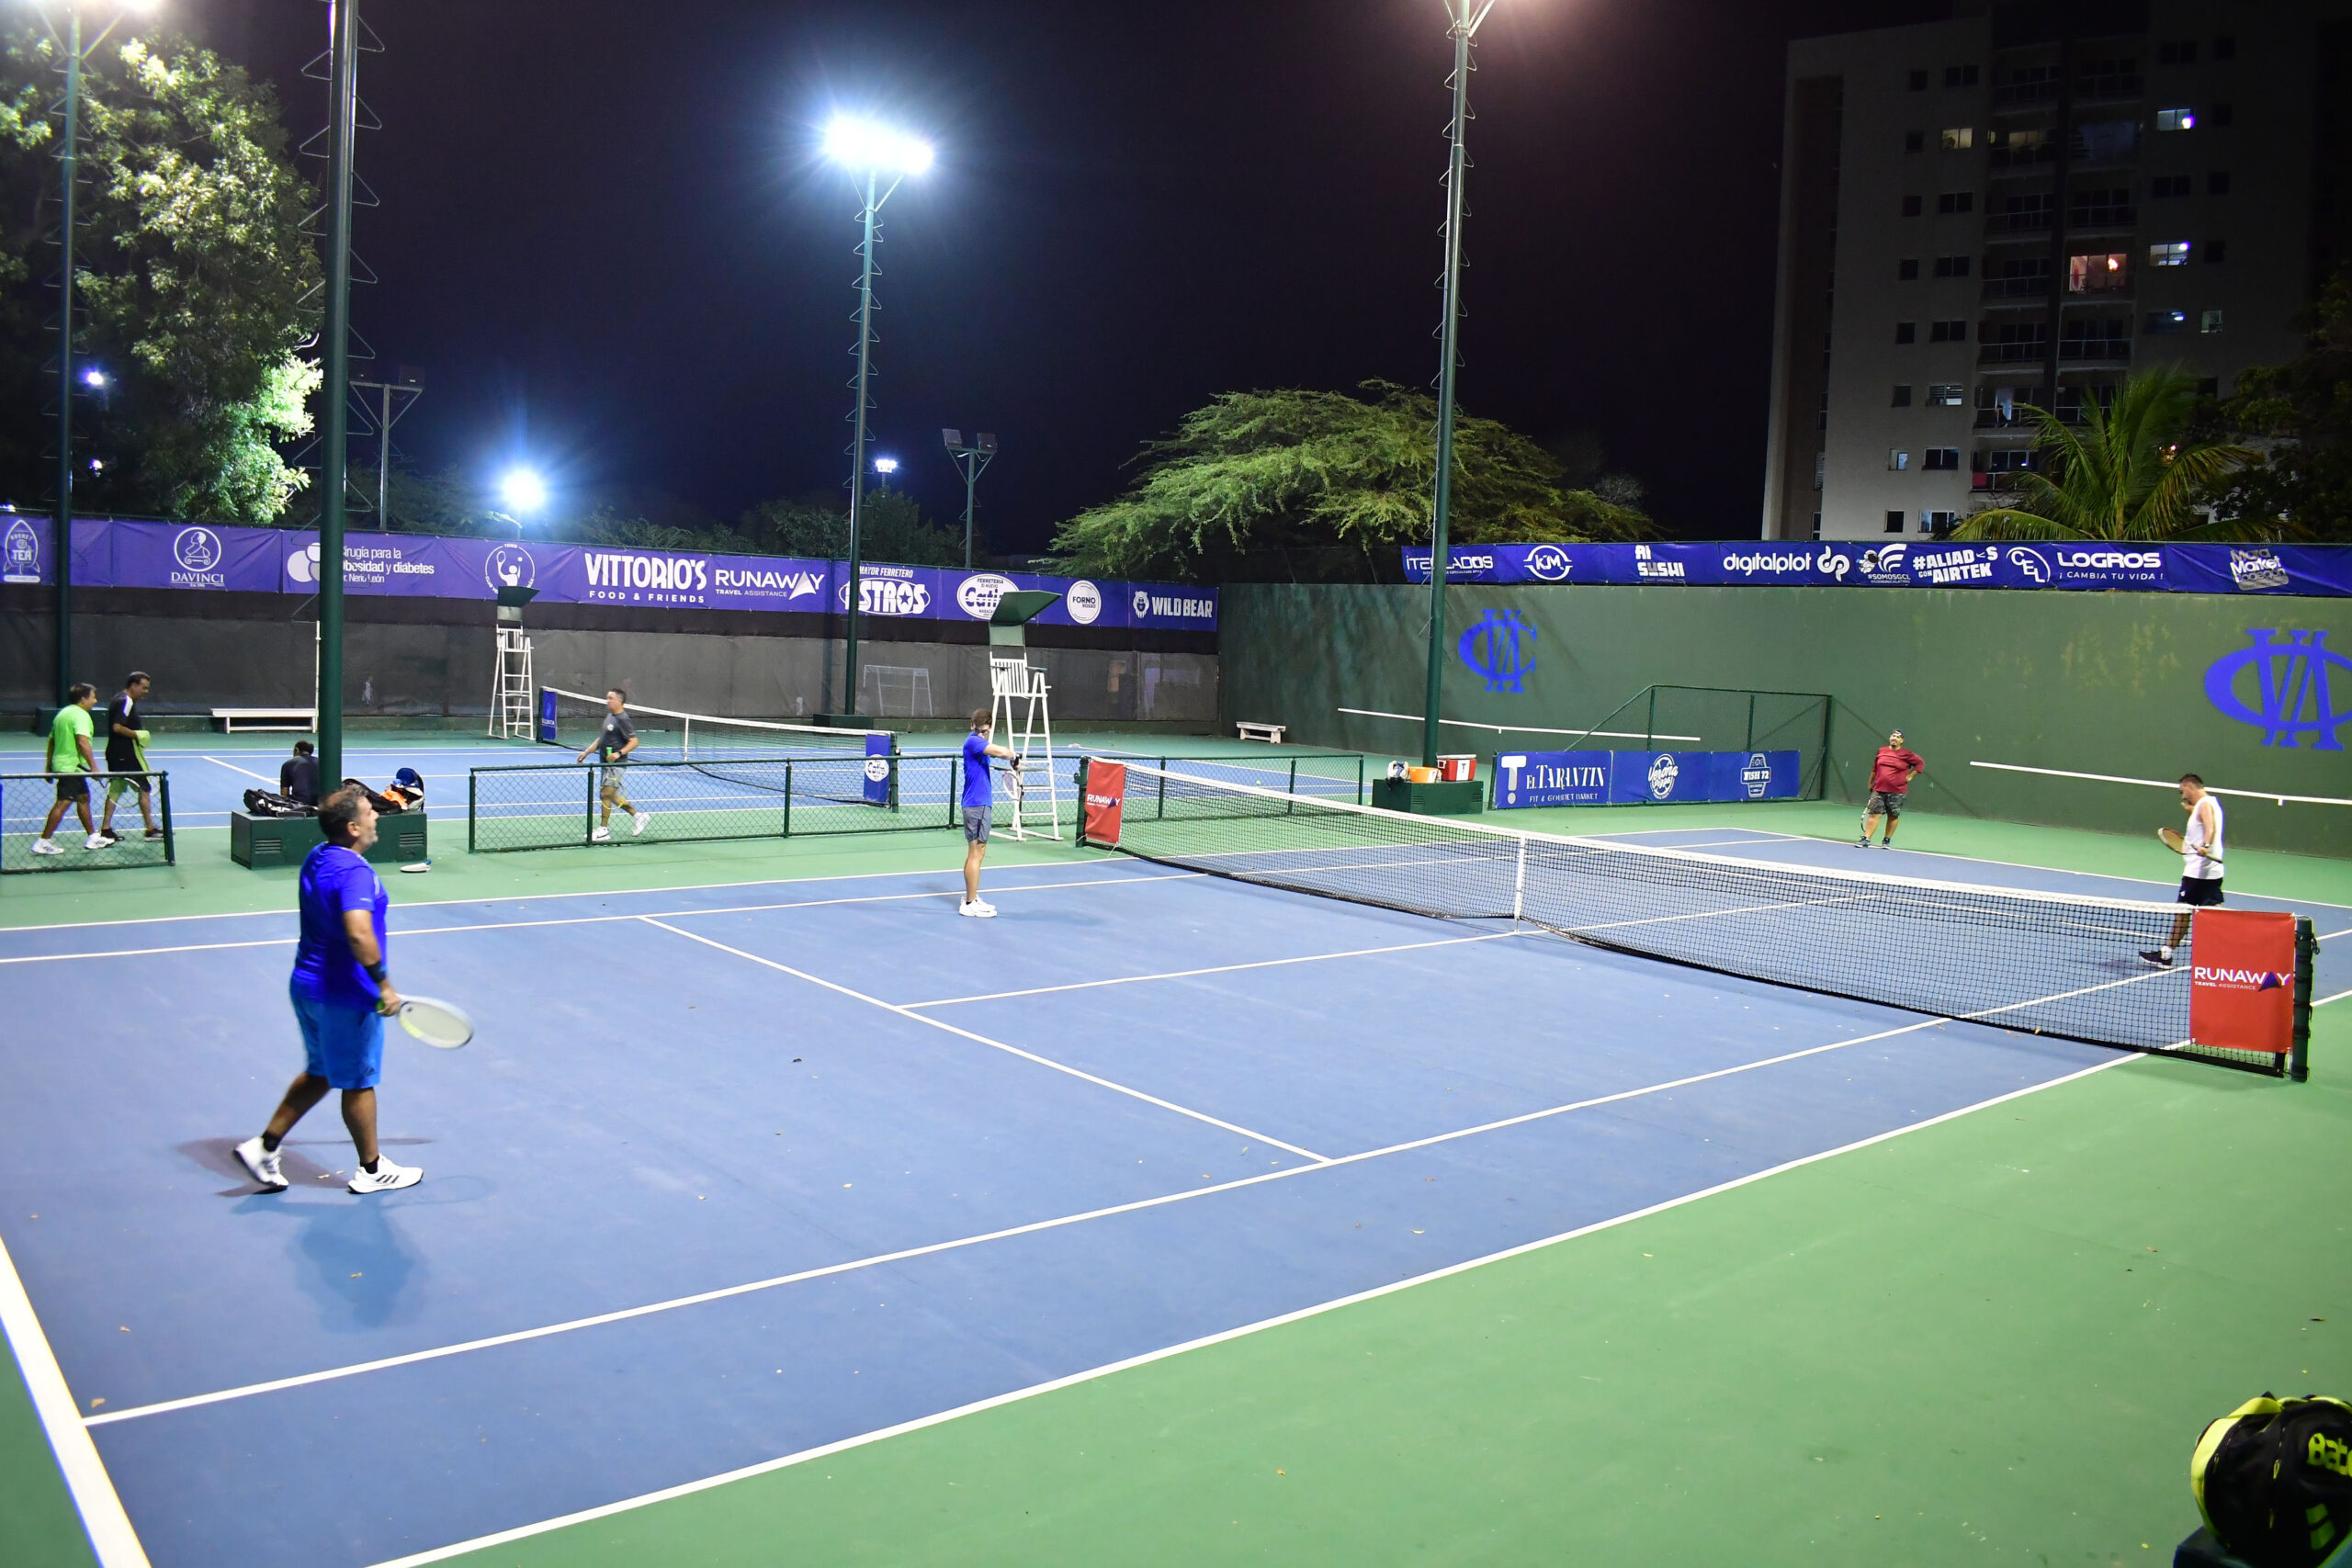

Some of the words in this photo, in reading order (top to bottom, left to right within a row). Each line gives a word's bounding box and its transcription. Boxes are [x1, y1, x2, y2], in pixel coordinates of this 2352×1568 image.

[12, 550, 32, 561] TEA
[371, 548, 391, 560] para
[393, 547, 401, 559] la
[1723, 552, 1812, 576] digitalplot
[2057, 552, 2162, 569] LOGROS
[386, 563, 391, 575] y
[393, 561, 435, 575] diabetes
[584, 553, 707, 591] VITTORIO'S
[880, 569, 914, 578] FERRETERO
[1637, 561, 1686, 577] SUSHI
[1918, 570, 1933, 579] CON
[1932, 562, 1993, 583] AIRTEK
[171, 572, 224, 583] DAVINCI
[2066, 571, 2107, 580] CAMBIA
[589, 591, 626, 600] FOOD
[633, 592, 640, 601] &
[648, 593, 705, 604] FRIENDS
[1072, 596, 1096, 604] FORNO
[1151, 596, 1182, 616] WILD
[1182, 598, 1214, 618] BEAR
